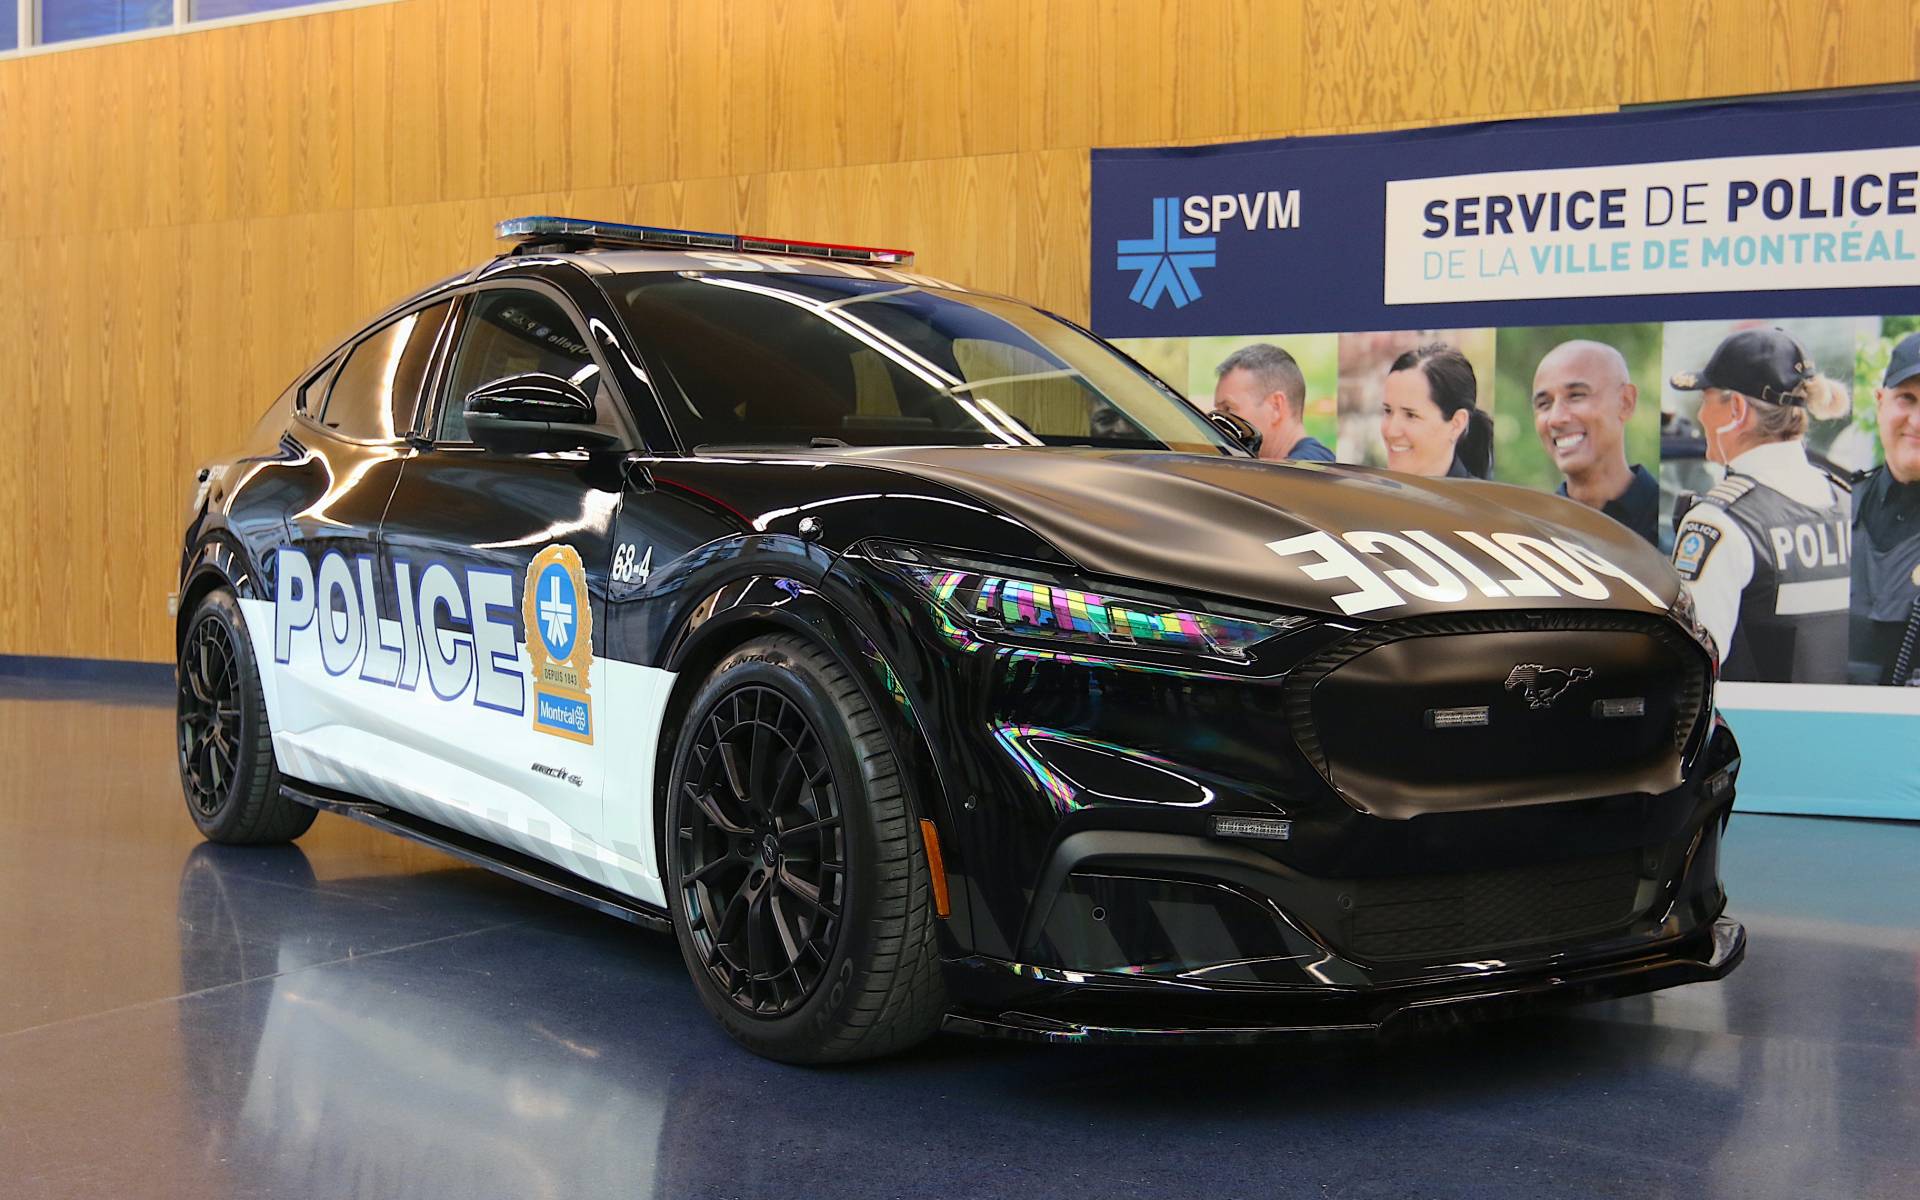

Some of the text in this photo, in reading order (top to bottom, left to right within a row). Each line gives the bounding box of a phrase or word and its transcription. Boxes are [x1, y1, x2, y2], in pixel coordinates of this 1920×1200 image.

[1183, 190, 1300, 234] SPVM
[1422, 172, 1919, 239] SERVICE DE POLICE
[1424, 220, 1916, 280] DE LA VILLE DE MONTRÉAL
[612, 543, 653, 584] 68-4
[1769, 520, 1852, 571] POLI
[275, 546, 525, 717] POLICE
[544, 667, 578, 686] DEPUIS 1843
[539, 699, 576, 726] Montréal
